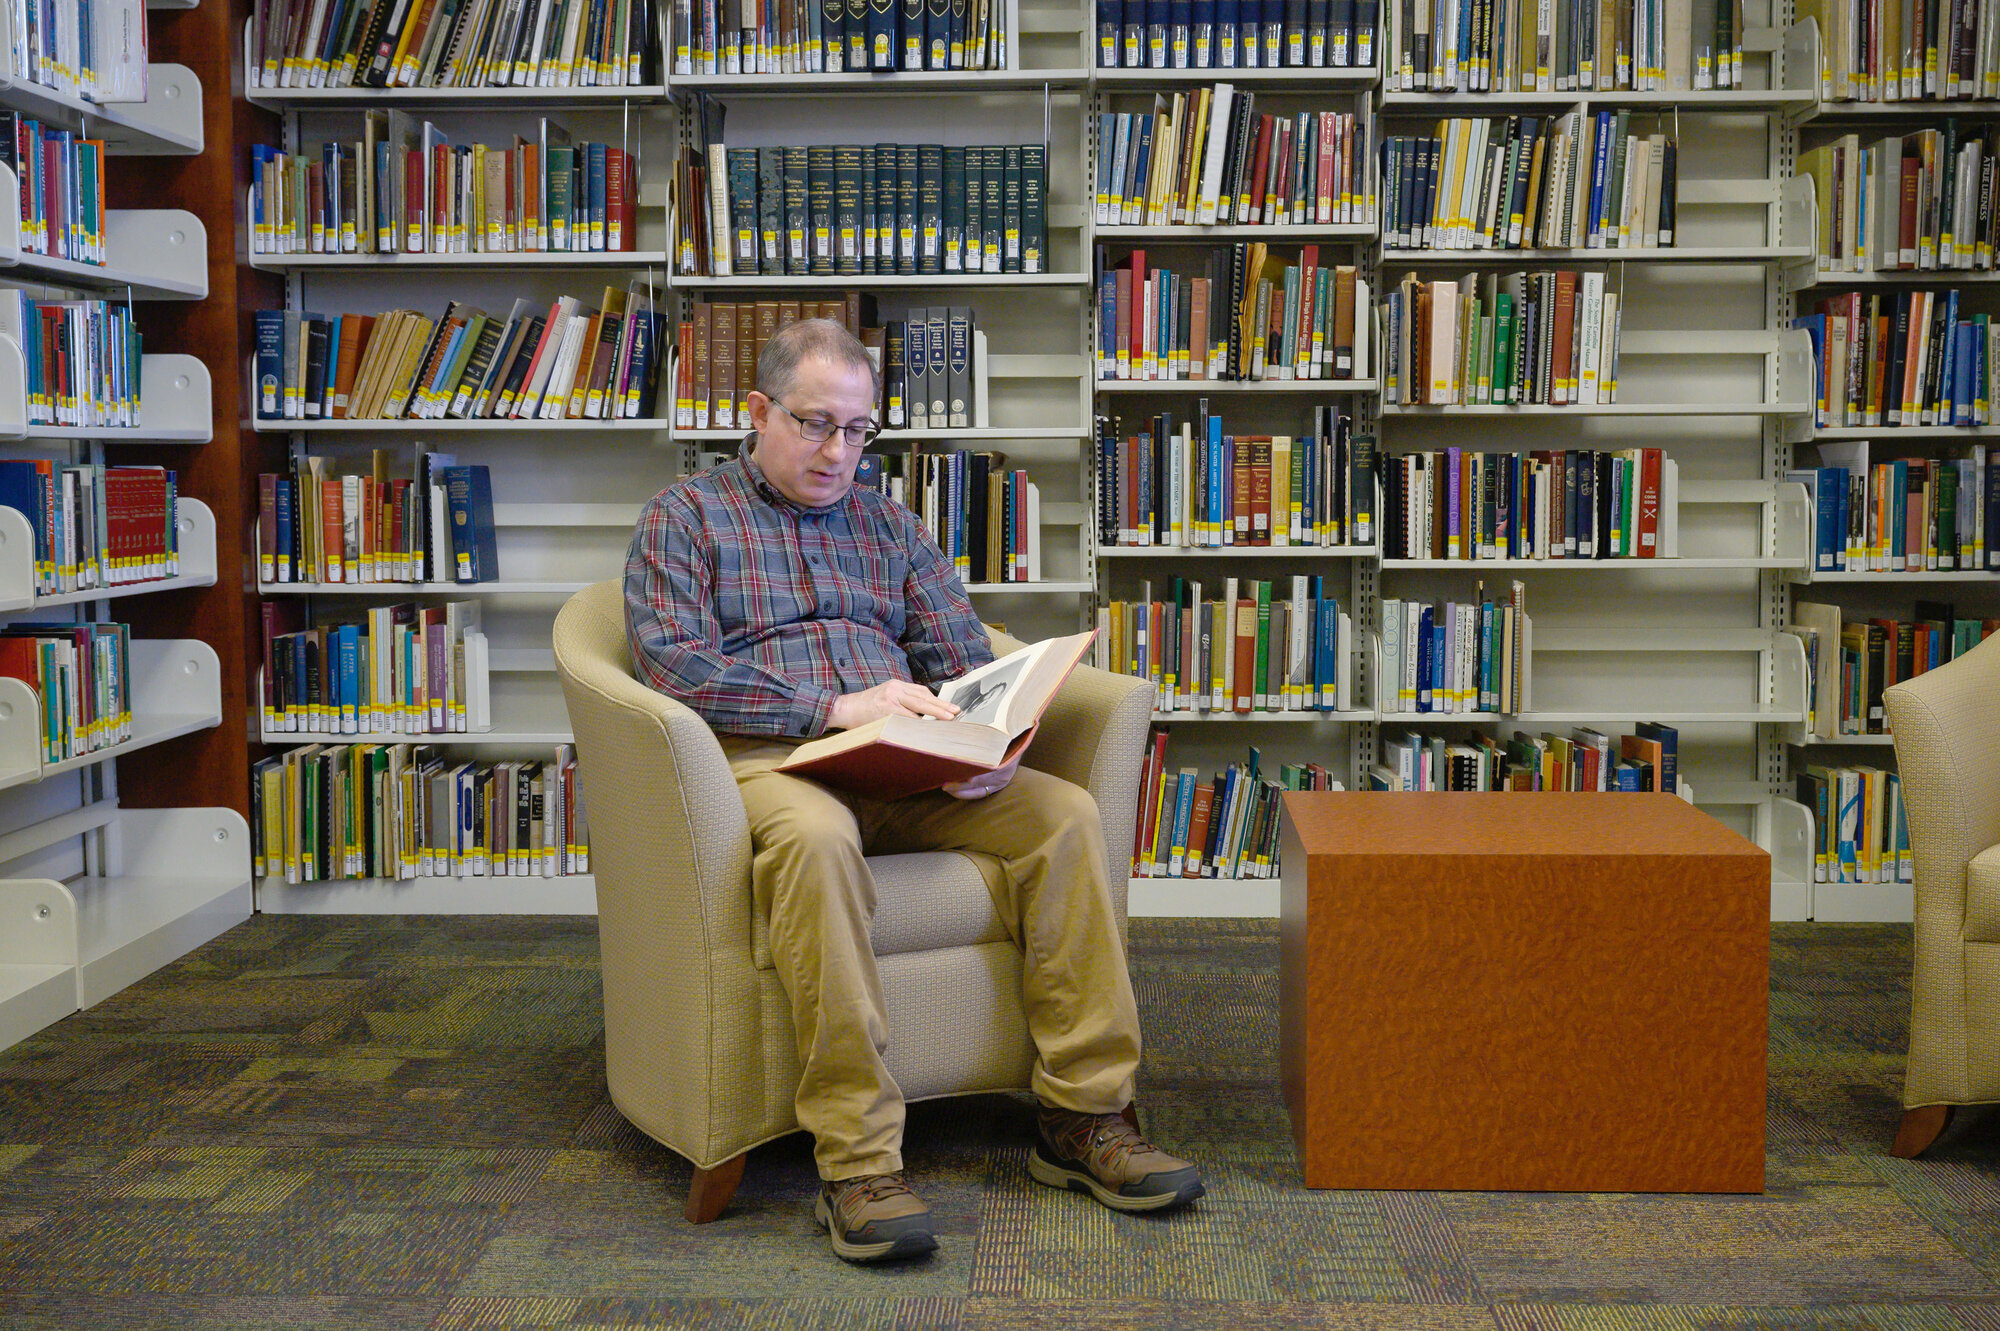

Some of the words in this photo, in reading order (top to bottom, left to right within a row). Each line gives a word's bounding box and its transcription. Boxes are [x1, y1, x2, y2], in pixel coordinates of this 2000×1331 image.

[704, 1, 713, 18] AVE
[704, 22, 713, 51] PATRO
[1482, 5, 1490, 51] STARWATCH
[1597, 160, 1605, 186] COLUMBIA
[1982, 163, 1990, 183] TRUE
[1980, 184, 1989, 220] LIKENESS
[1106, 454, 1115, 481] FURMAN
[1106, 484, 1115, 521] UNIVERSITY
[1450, 472, 1459, 510] CHARLESTON
[1384, 604, 1398, 656] FOOD
[1408, 622, 1416, 643] Southern
[1408, 644, 1416, 661] Recipes
[1408, 668, 1416, 687] Legends
[545, 791, 553, 825] Democracy
